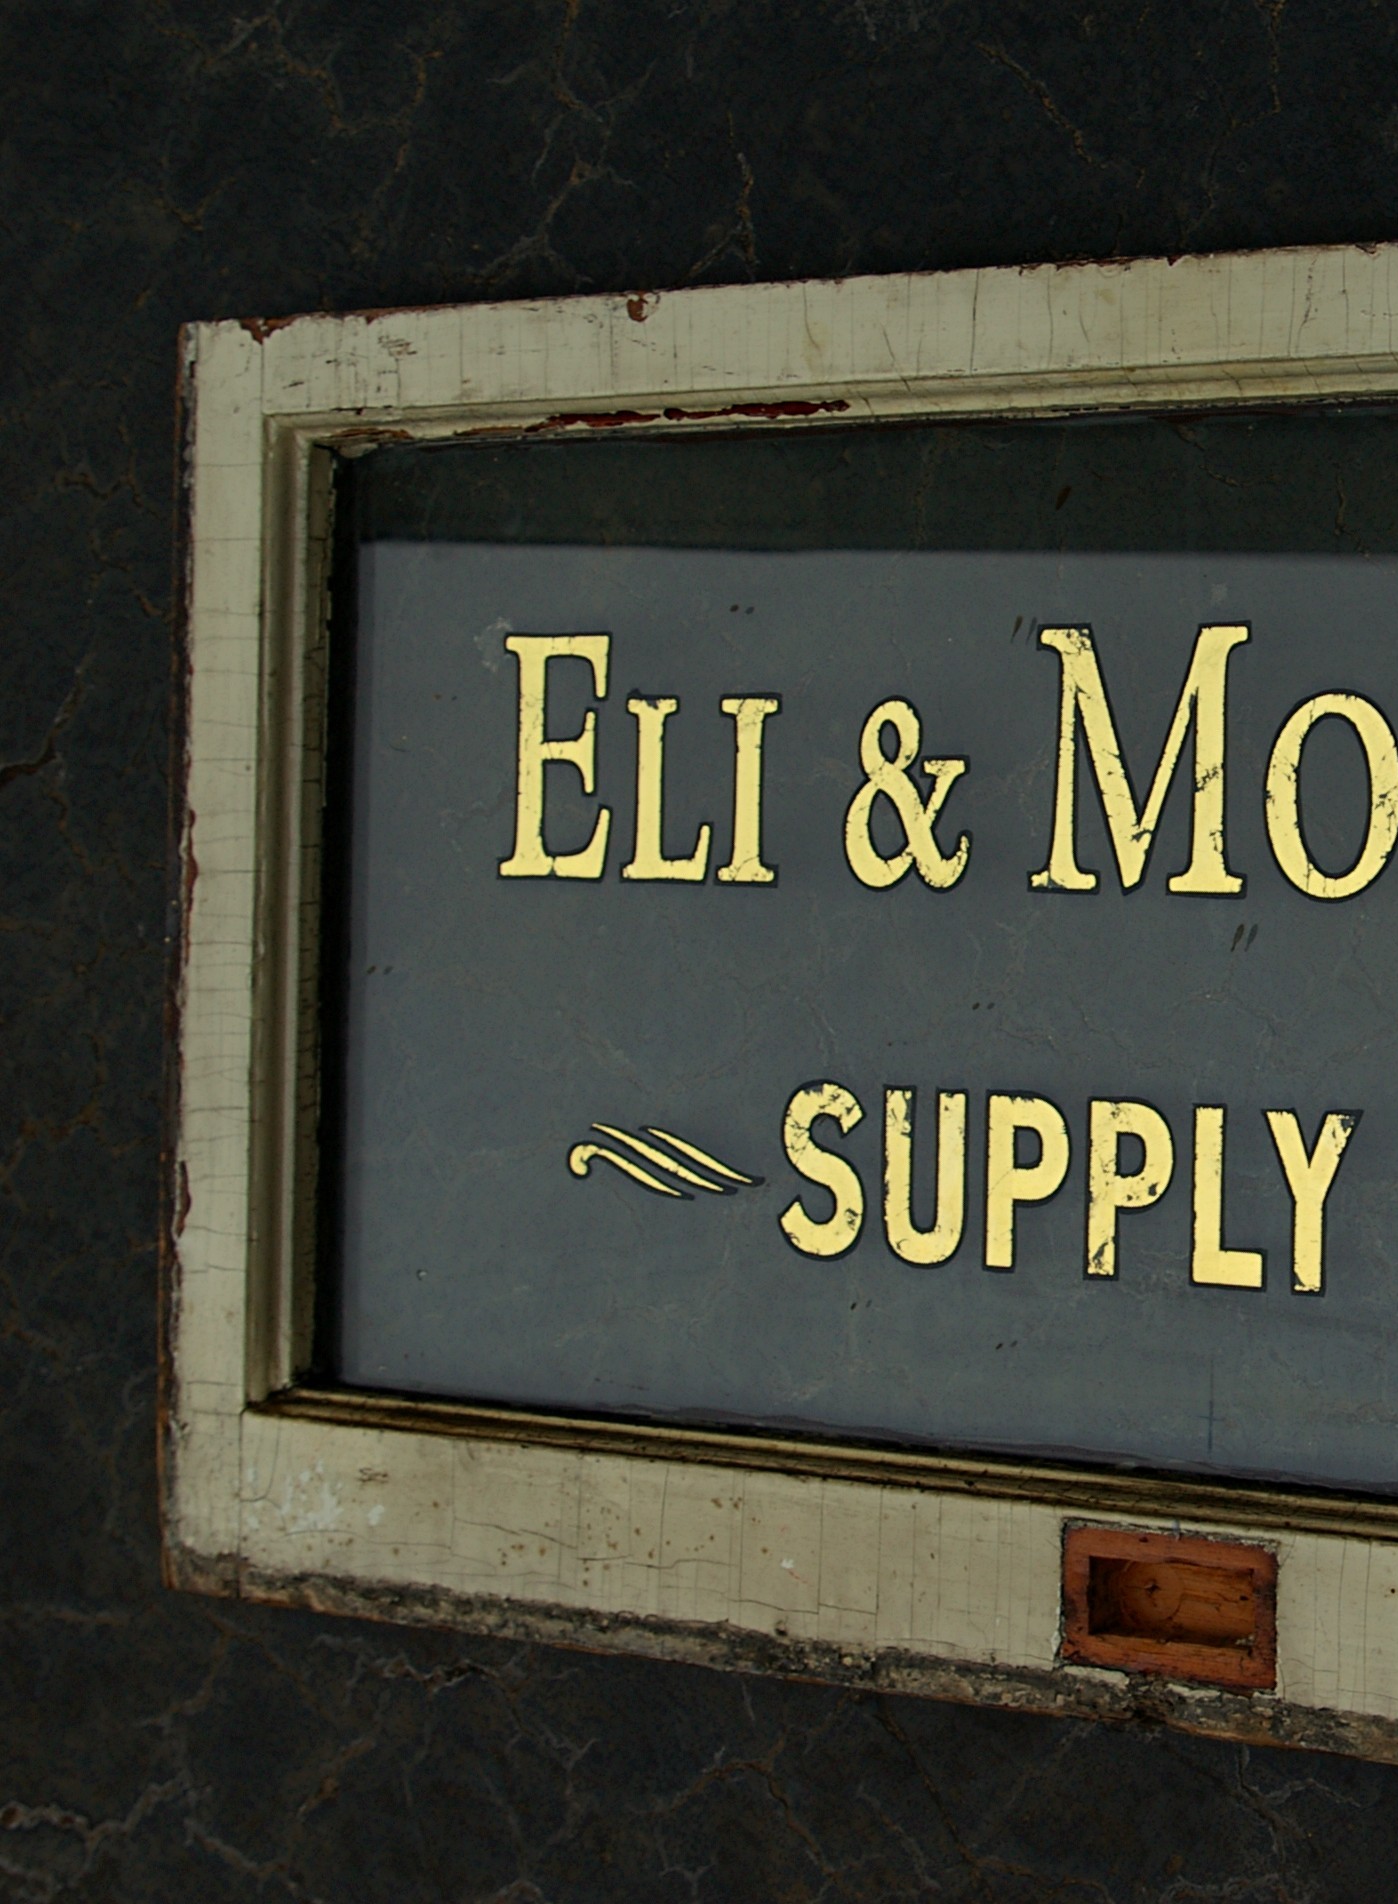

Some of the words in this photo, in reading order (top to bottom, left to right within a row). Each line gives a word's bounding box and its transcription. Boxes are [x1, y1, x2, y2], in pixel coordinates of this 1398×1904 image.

[497, 631, 780, 887] ELI
[842, 697, 972, 891] &
[778, 1081, 1358, 1295] SUPPLY
